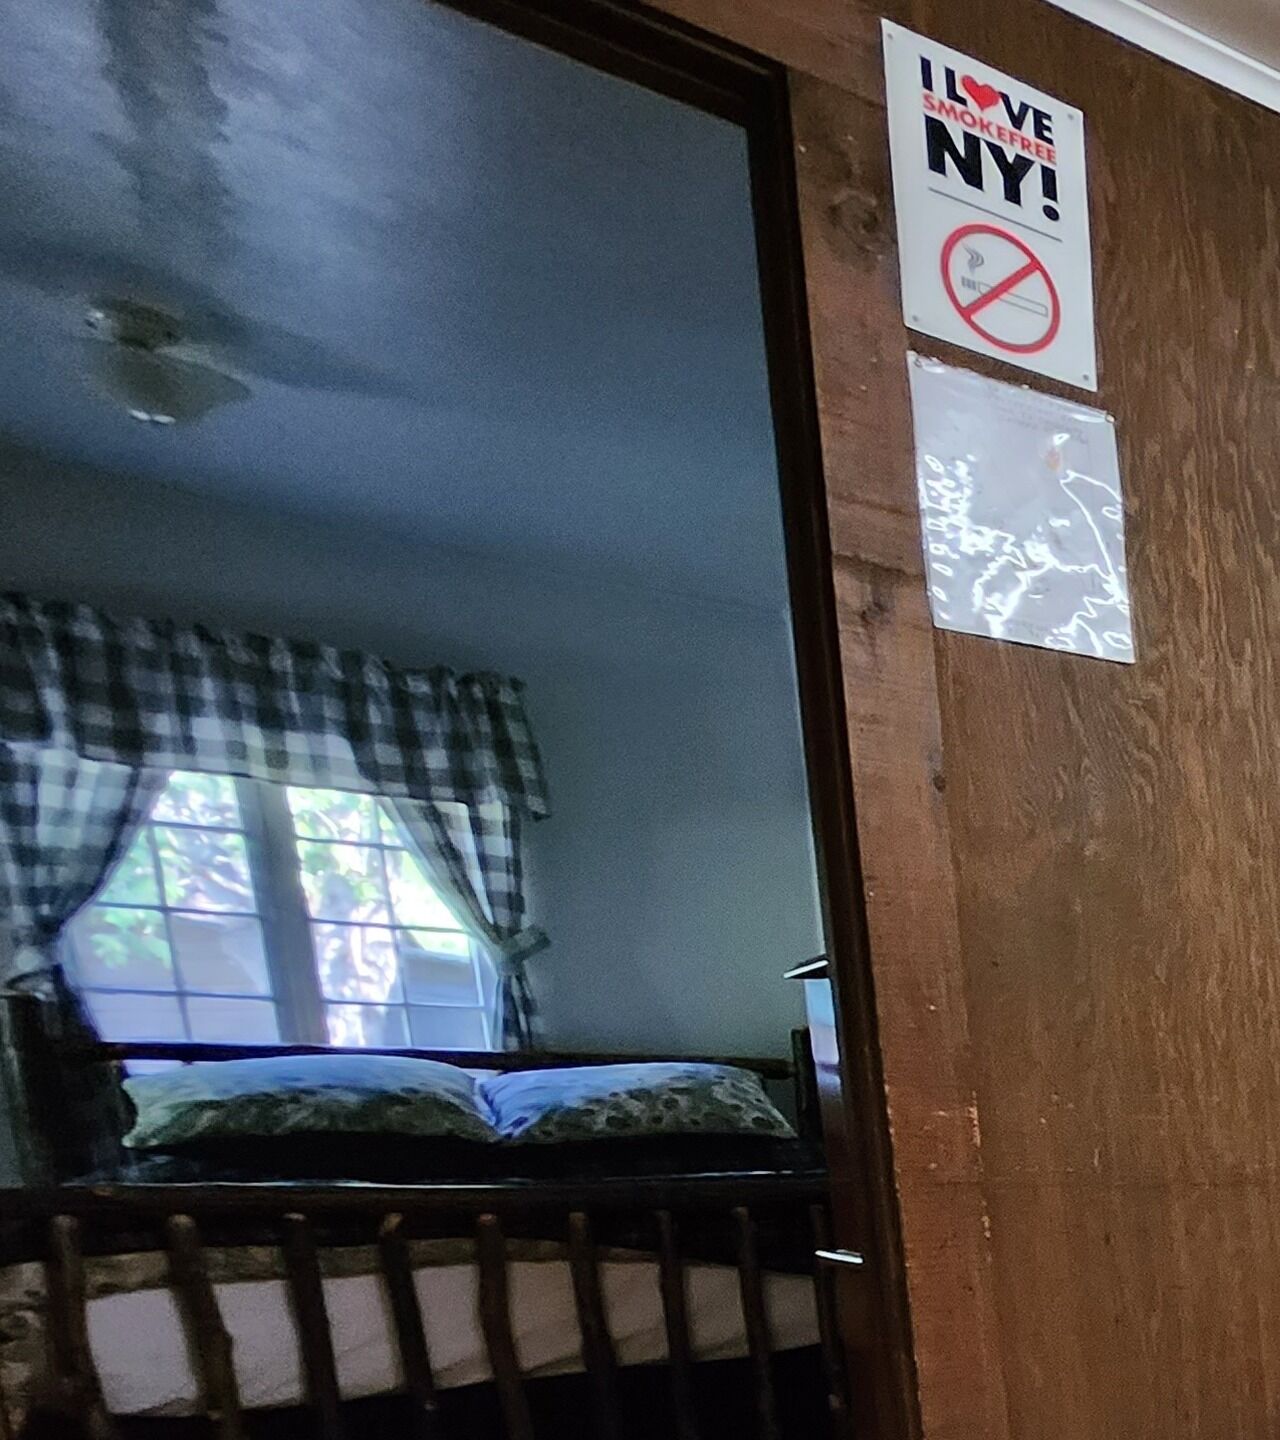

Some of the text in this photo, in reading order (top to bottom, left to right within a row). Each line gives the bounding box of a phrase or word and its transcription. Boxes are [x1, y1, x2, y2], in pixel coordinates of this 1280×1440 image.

[920, 55, 932, 91] I
[922, 92, 1057, 166] SMOKEFREE
[924, 113, 1060, 222] NY!
